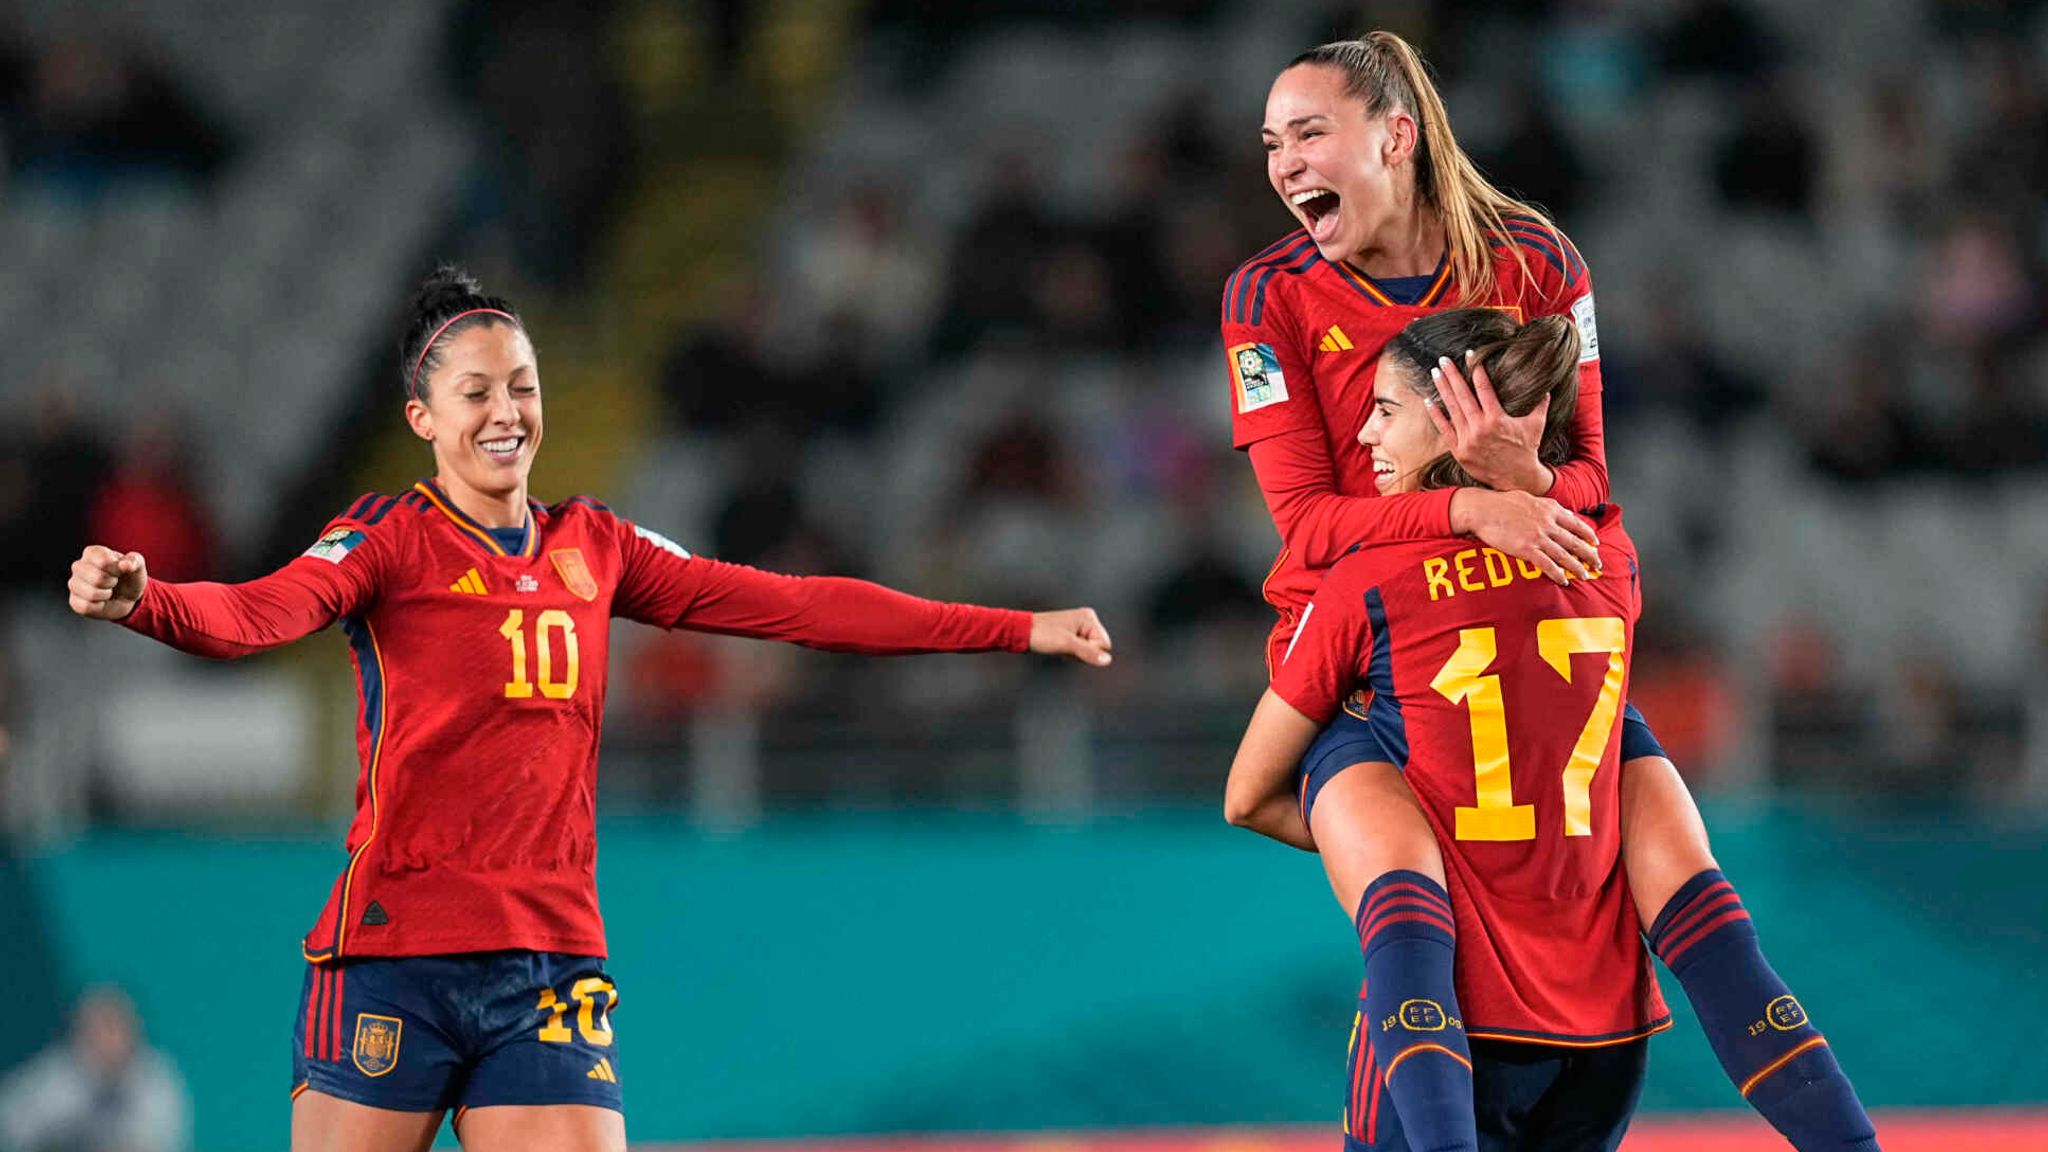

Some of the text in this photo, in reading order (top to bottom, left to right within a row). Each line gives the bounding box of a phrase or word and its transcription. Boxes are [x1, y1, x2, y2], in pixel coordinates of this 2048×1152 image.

[499, 609, 579, 699] 10
[1430, 617, 1625, 841] 17
[536, 977, 617, 1047] 10
[1382, 1015, 1396, 1031] 19
[1748, 1020, 1766, 1036] 19
